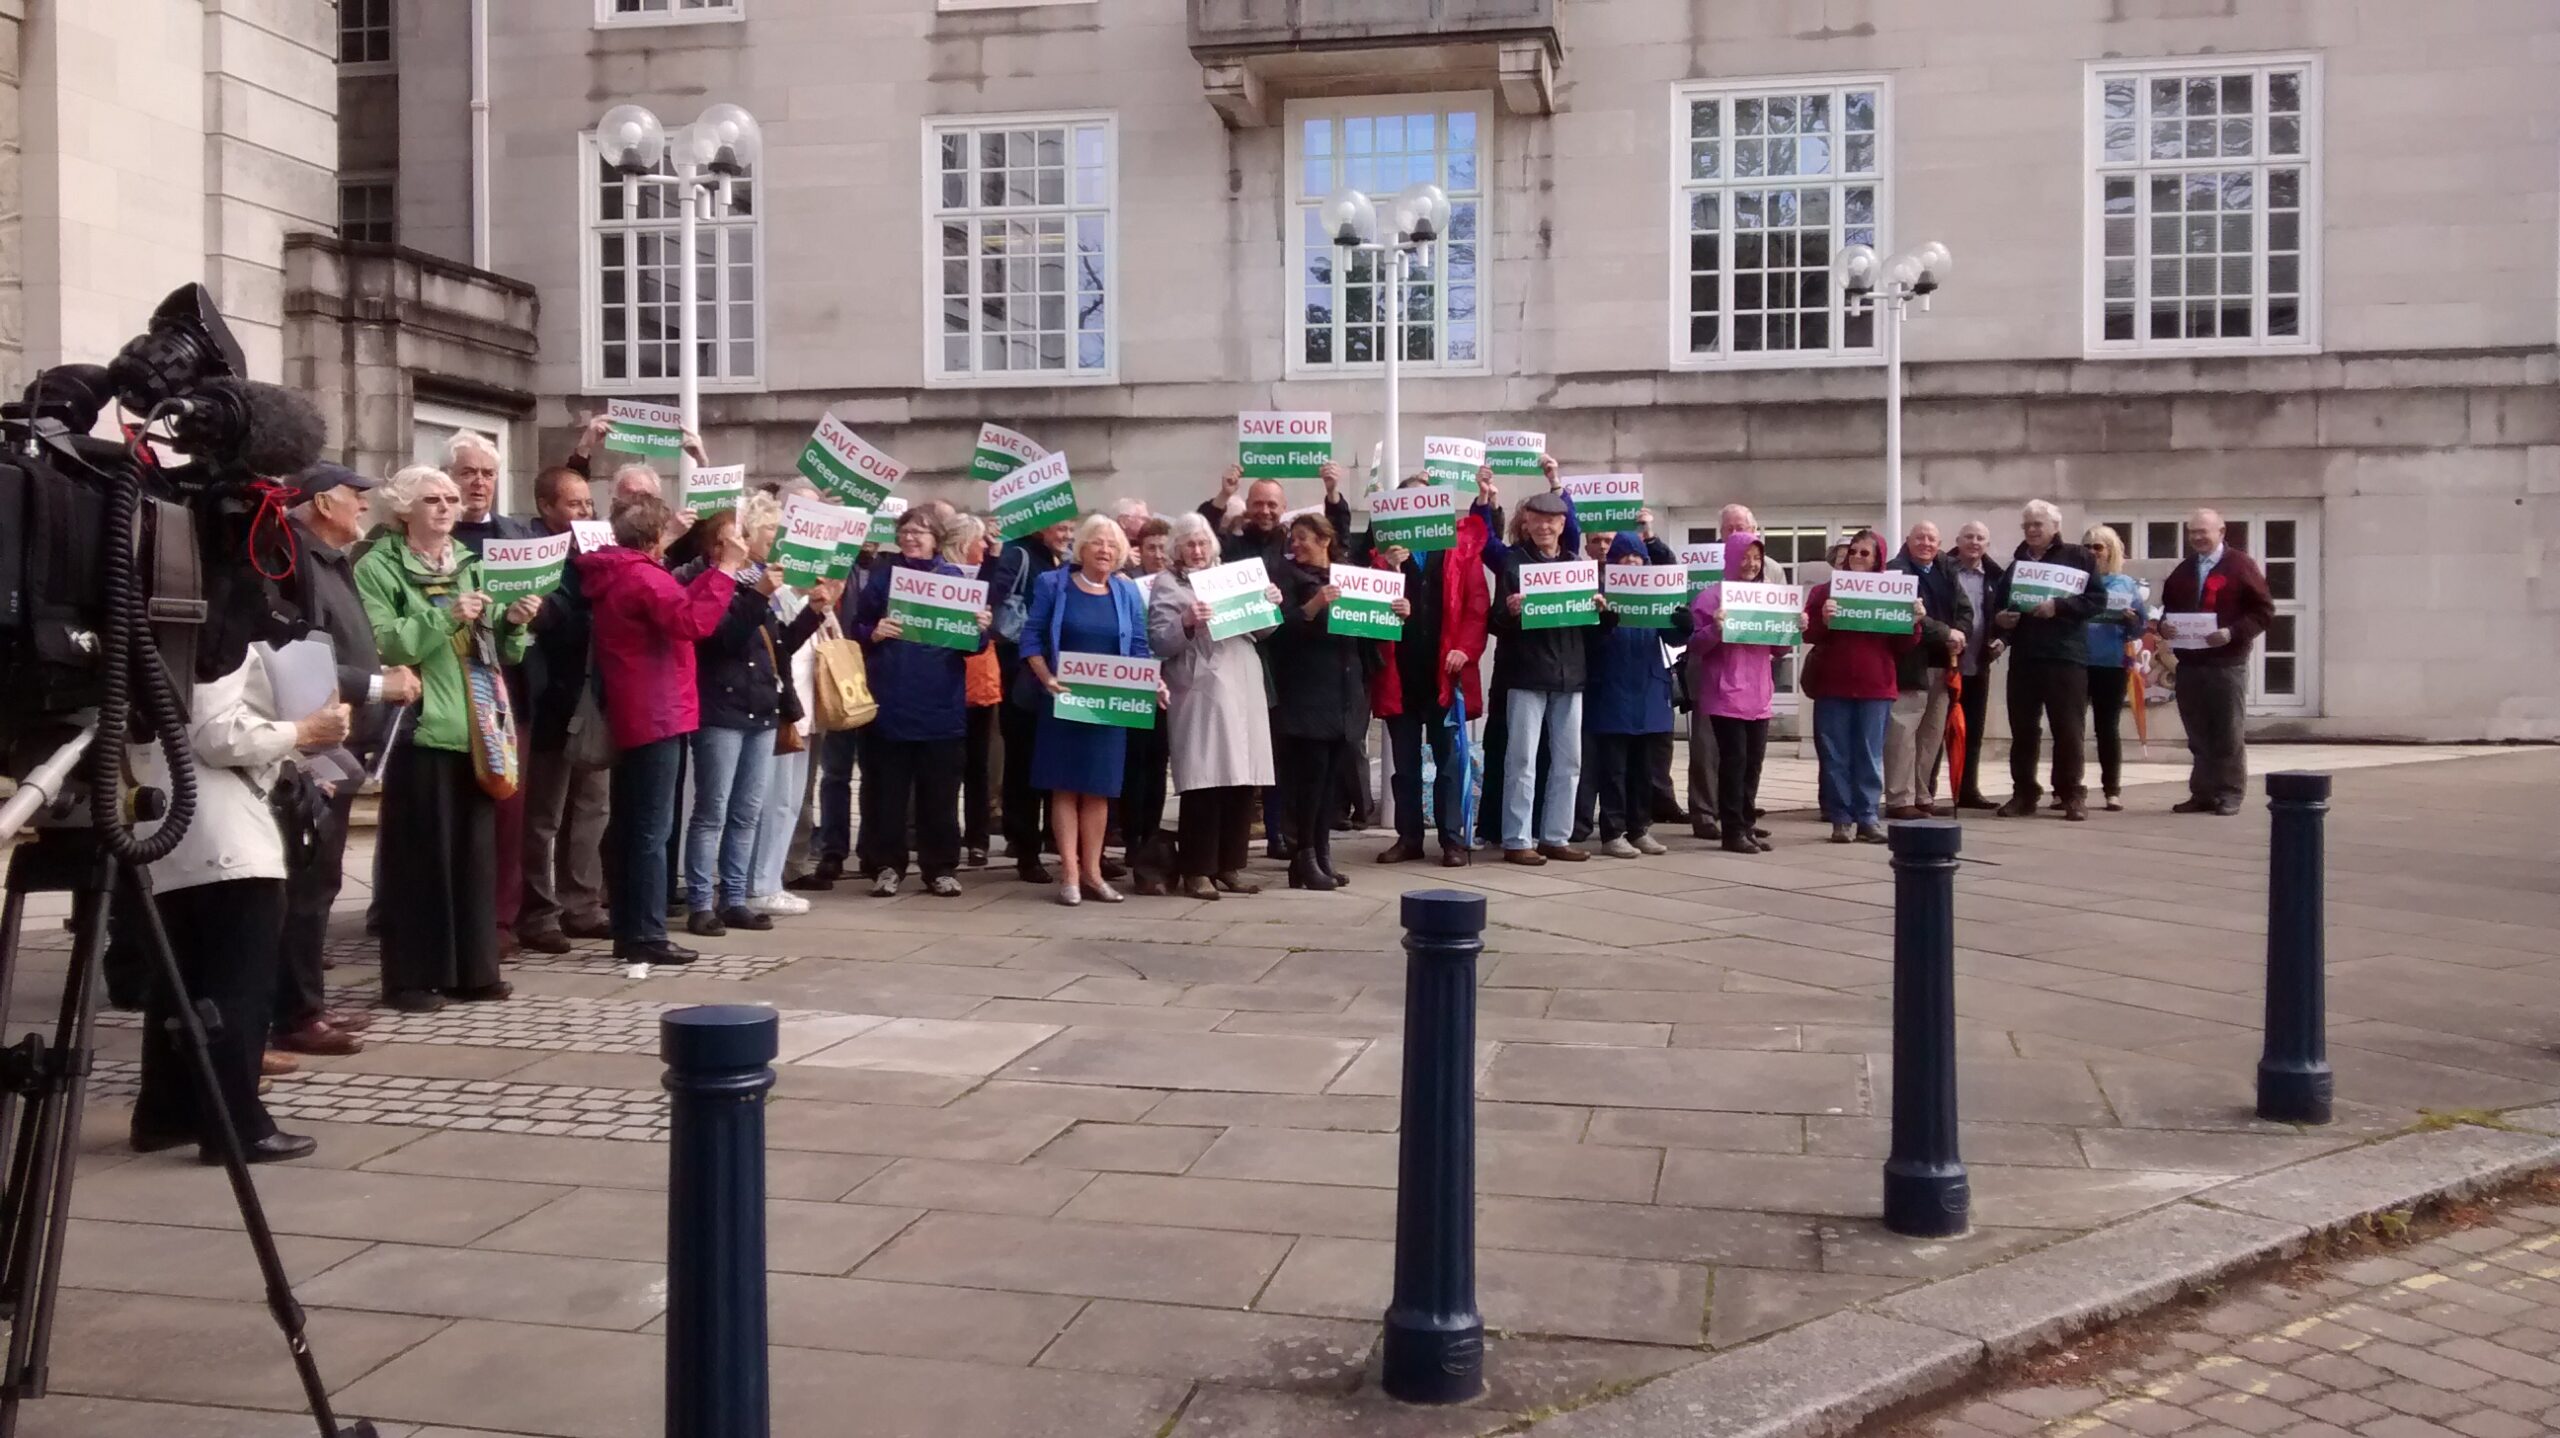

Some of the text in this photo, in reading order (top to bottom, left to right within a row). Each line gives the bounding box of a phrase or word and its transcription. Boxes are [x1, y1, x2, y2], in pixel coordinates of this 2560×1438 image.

[612, 405, 681, 424] SAVE OUR
[1243, 419, 1327, 434] SAVE OUR
[647, 434, 680, 447] Fields
[983, 431, 1019, 451] SAVE
[1487, 436, 1543, 448] SAVE OUR
[820, 423, 899, 482] SAVE OUR
[1242, 451, 1329, 465] Green Fields
[1428, 442, 1461, 457] SAVE
[975, 456, 1010, 472] Green
[1485, 456, 1538, 467] Green Field
[691, 473, 720, 486] SAVE
[806, 449, 881, 506] Green Fields
[991, 462, 1064, 502] SAVE OUR
[1427, 466, 1476, 483] Green Fie
[1564, 481, 1640, 496] SAVE OUR
[1033, 492, 1073, 516] Fields
[1373, 493, 1450, 514] SAVE OUR
[1575, 511, 1603, 522] reen
[791, 518, 823, 540] SAVE
[1375, 523, 1454, 542] Green Fields
[487, 540, 567, 562] SAVE OUR
[831, 552, 854, 567] elds
[1681, 551, 1719, 564] SAVE
[487, 580, 532, 592] Green
[1335, 574, 1401, 596] SAVE OUR
[1524, 568, 1595, 587] SAVE OUR
[1609, 572, 1684, 587] SAVE OUR
[2016, 567, 2085, 590] SAVE OUR
[895, 576, 982, 604] SAVE OUR
[1835, 578, 1913, 596] SAVE OUR
[1726, 590, 1799, 606] SAVE OUR
[2011, 591, 2044, 604] Green
[1524, 598, 1596, 616] Green Fields
[1608, 601, 1648, 615] Green
[1874, 608, 1912, 622] Fields
[1332, 606, 1400, 627] Green Fields
[935, 617, 978, 636] Fields
[1725, 618, 1800, 633] Green Fields
[1063, 661, 1154, 682] SAVE OUR
[1059, 692, 1153, 714] Green Fields
